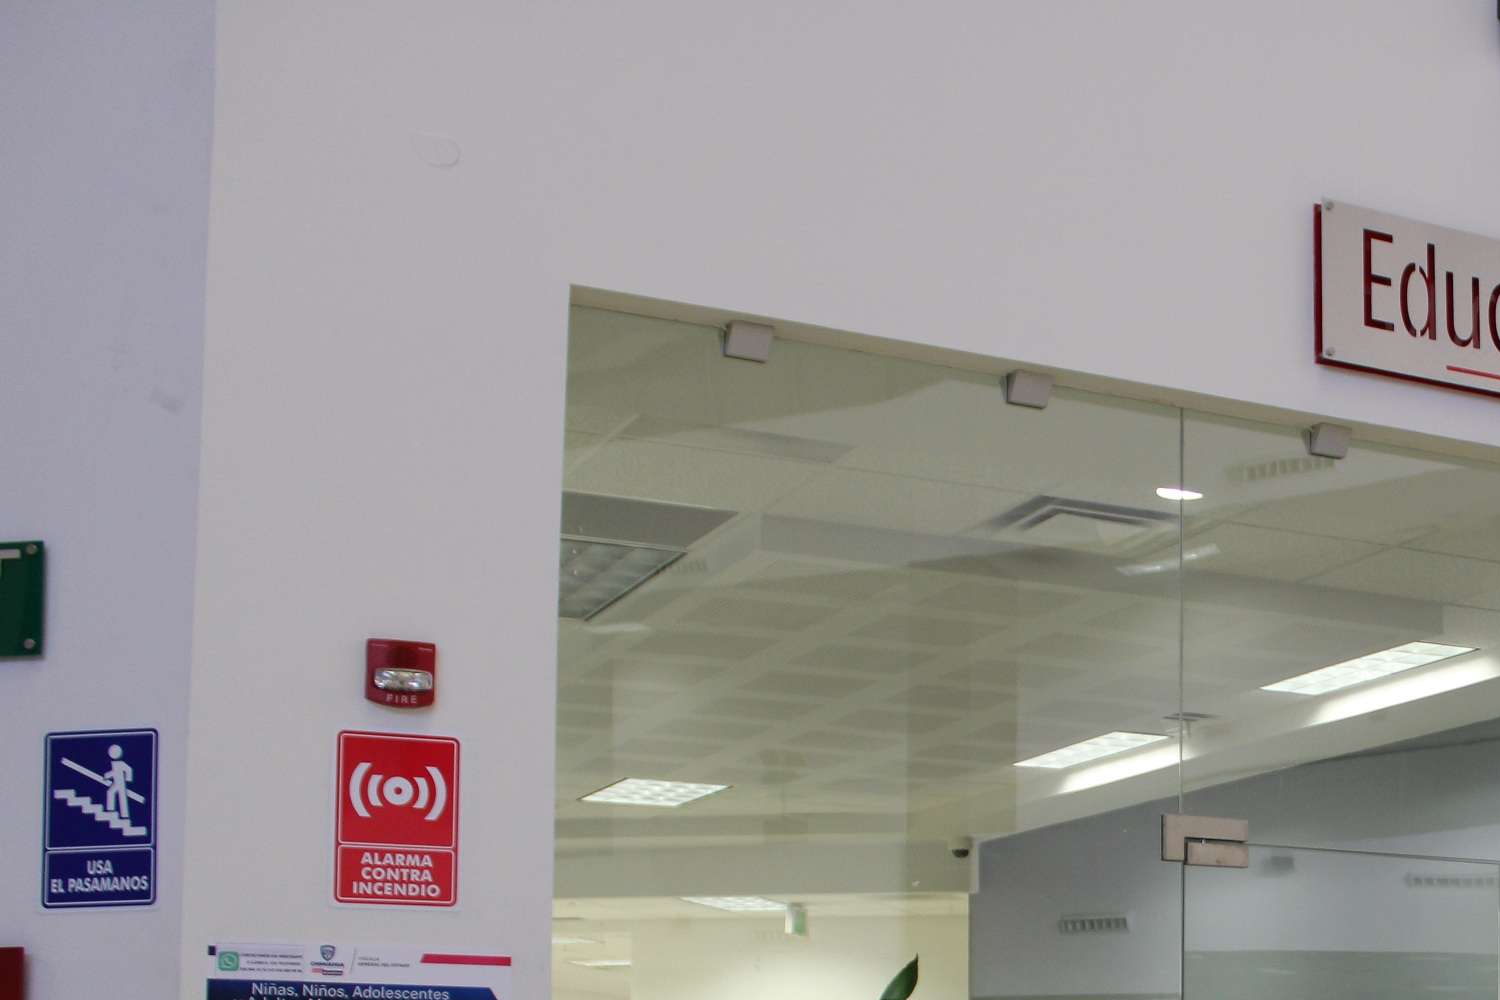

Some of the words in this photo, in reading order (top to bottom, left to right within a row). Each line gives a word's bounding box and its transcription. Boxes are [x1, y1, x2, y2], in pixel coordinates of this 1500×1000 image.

[386, 693, 417, 704] FIRE
[361, 852, 433, 867] ALARMA
[87, 860, 113, 875] USA
[361, 867, 433, 882] CONTRA
[51, 879, 65, 893] EL
[68, 876, 148, 893] PASAMANOS
[352, 881, 440, 897] INCENDIO
[252, 982, 298, 998] Niñas,
[303, 984, 349, 999] Niños,
[352, 985, 449, 1000] Adolescentes
